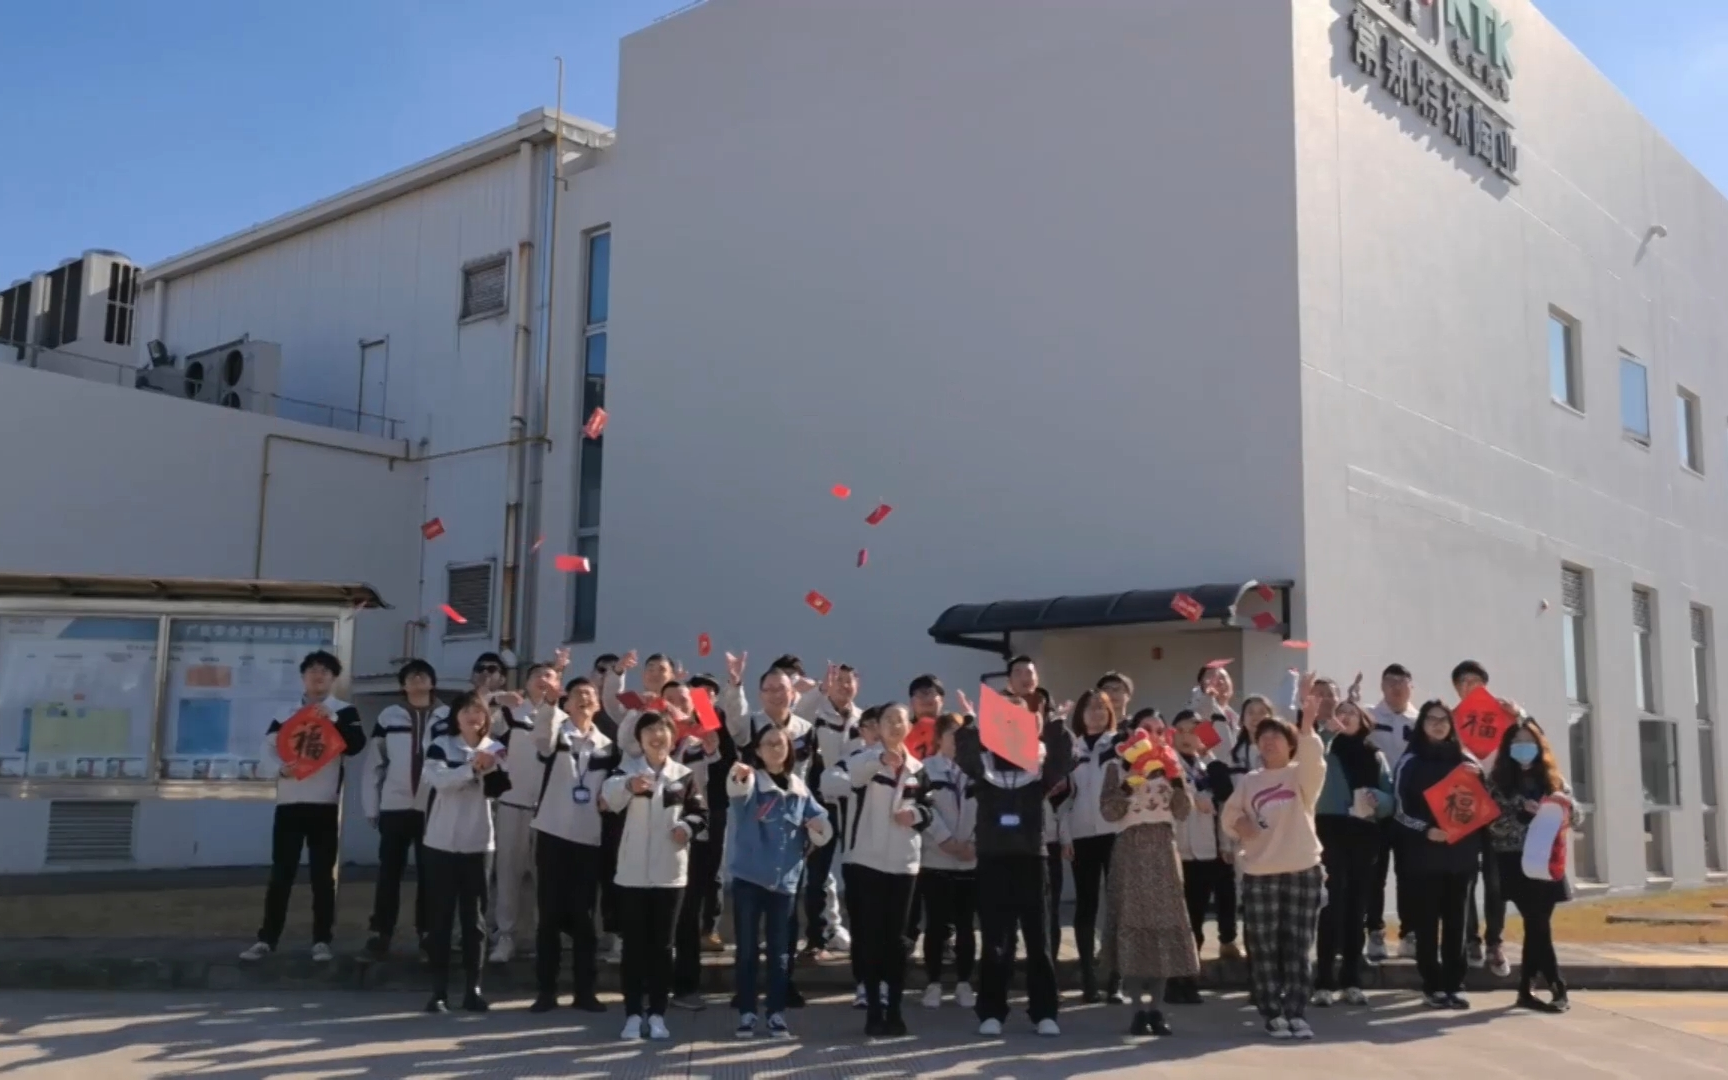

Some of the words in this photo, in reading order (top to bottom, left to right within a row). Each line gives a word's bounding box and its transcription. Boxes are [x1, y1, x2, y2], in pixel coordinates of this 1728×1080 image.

[1444, 0, 1513, 79] NTK
[292, 722, 327, 760] 福
[1460, 712, 1497, 738] 福
[1444, 785, 1475, 824] 福
